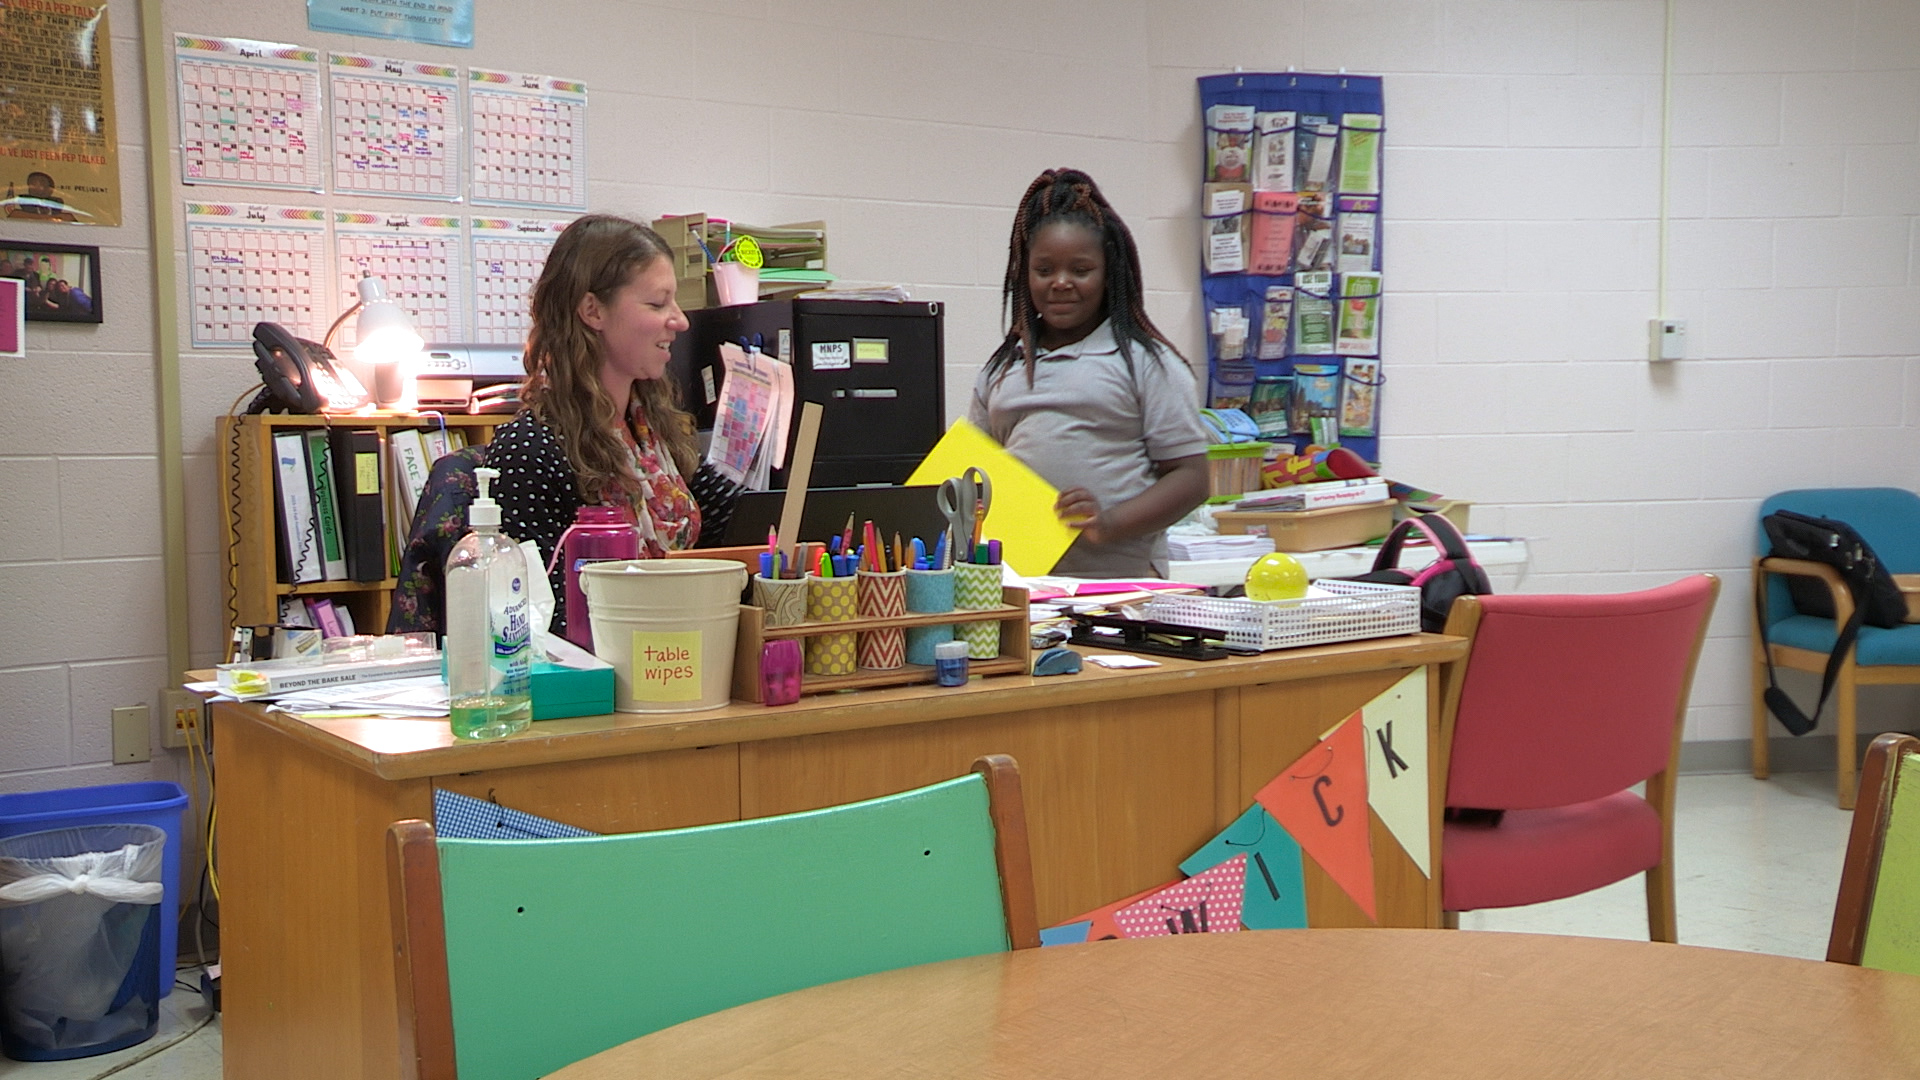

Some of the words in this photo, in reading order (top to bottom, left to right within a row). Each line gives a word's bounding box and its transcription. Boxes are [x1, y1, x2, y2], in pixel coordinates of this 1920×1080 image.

[20, 0, 43, 10] NEED
[45, 2, 52, 12] A
[54, 4, 71, 14] PEP
[72, 5, 95, 18] TALK
[370, 9, 383, 17] PUT
[403, 13, 426, 22] THINGS
[428, 16, 446, 25] FIRST
[46, 16, 70, 26] THAN
[240, 49, 263, 58] April
[385, 64, 403, 77] May
[522, 81, 540, 89] June
[21, 148, 38, 159] JUST
[40, 151, 60, 161] BEEN
[62, 153, 76, 163] PEP
[78, 154, 108, 165] TALKED.
[246, 211, 266, 222] July
[386, 219, 410, 231] August
[517, 225, 546, 233] September
[820, 344, 843, 353] MNPS
[404, 447, 421, 481] FACE
[324, 516, 333, 535] Cards
[510, 613, 526, 632] HAND
[644, 645, 690, 662] table
[279, 680, 306, 689] BEYOND
[308, 678, 320, 686] THE
[321, 676, 339, 684] BAKE
[340, 674, 356, 682] SALE
[645, 665, 694, 686] wipes
[1376, 720, 1409, 779] K
[1313, 775, 1344, 827] C
[1254, 852, 1281, 901] I
